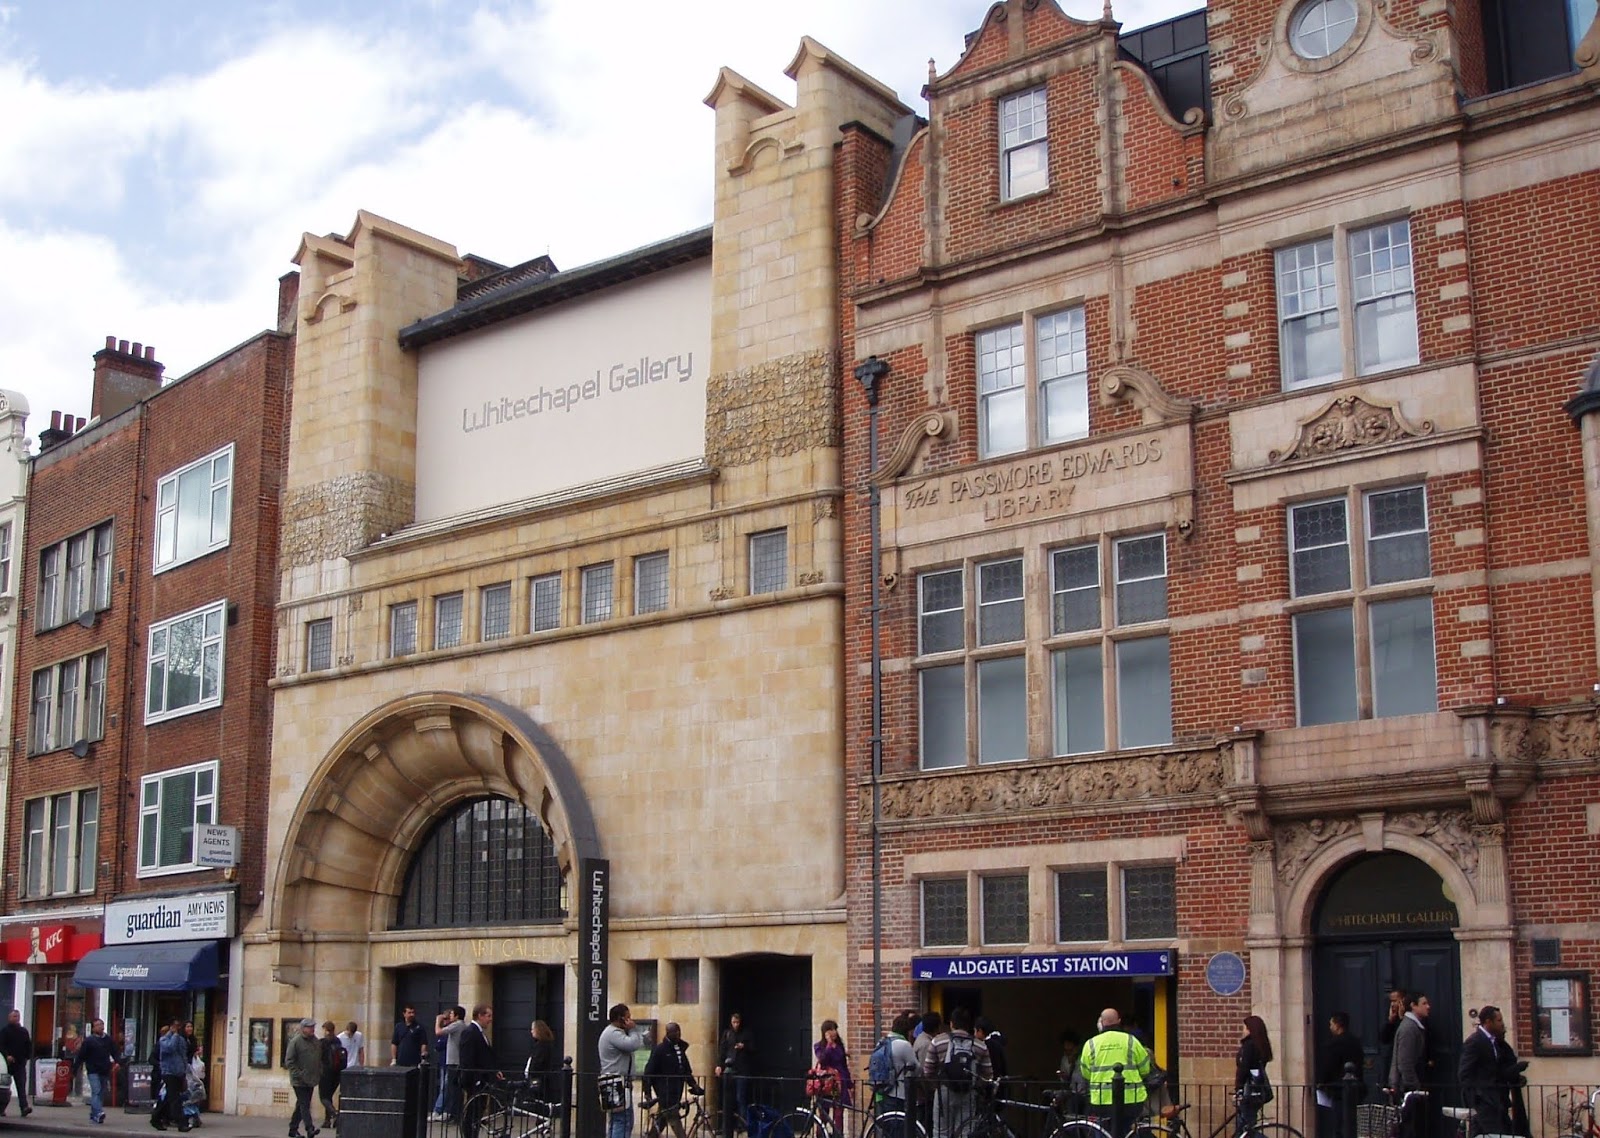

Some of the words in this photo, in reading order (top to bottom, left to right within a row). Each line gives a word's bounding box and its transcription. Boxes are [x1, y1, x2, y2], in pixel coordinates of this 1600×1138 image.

[462, 370, 600, 433] Whitechapel
[608, 352, 693, 393] Gallery
[905, 482, 940, 511] THE
[950, 461, 1053, 504] PASSMORE
[1060, 437, 1163, 481] EDWARDS
[983, 484, 1075, 522] LIBRARY
[203, 837, 230, 846] AGENTS
[207, 828, 228, 836] NEWS
[126, 905, 182, 938] guardian
[187, 902, 202, 916] AMY
[204, 900, 225, 915] NEWS
[589, 871, 604, 964] Whitechapel
[1406, 910, 1455, 923] GALLERY
[46, 928, 63, 952] KFC
[947, 960, 1015, 975] ALDGATE
[1021, 957, 1058, 973] EAST
[1064, 956, 1129, 973] STATION
[588, 969, 603, 1021] Gallery
